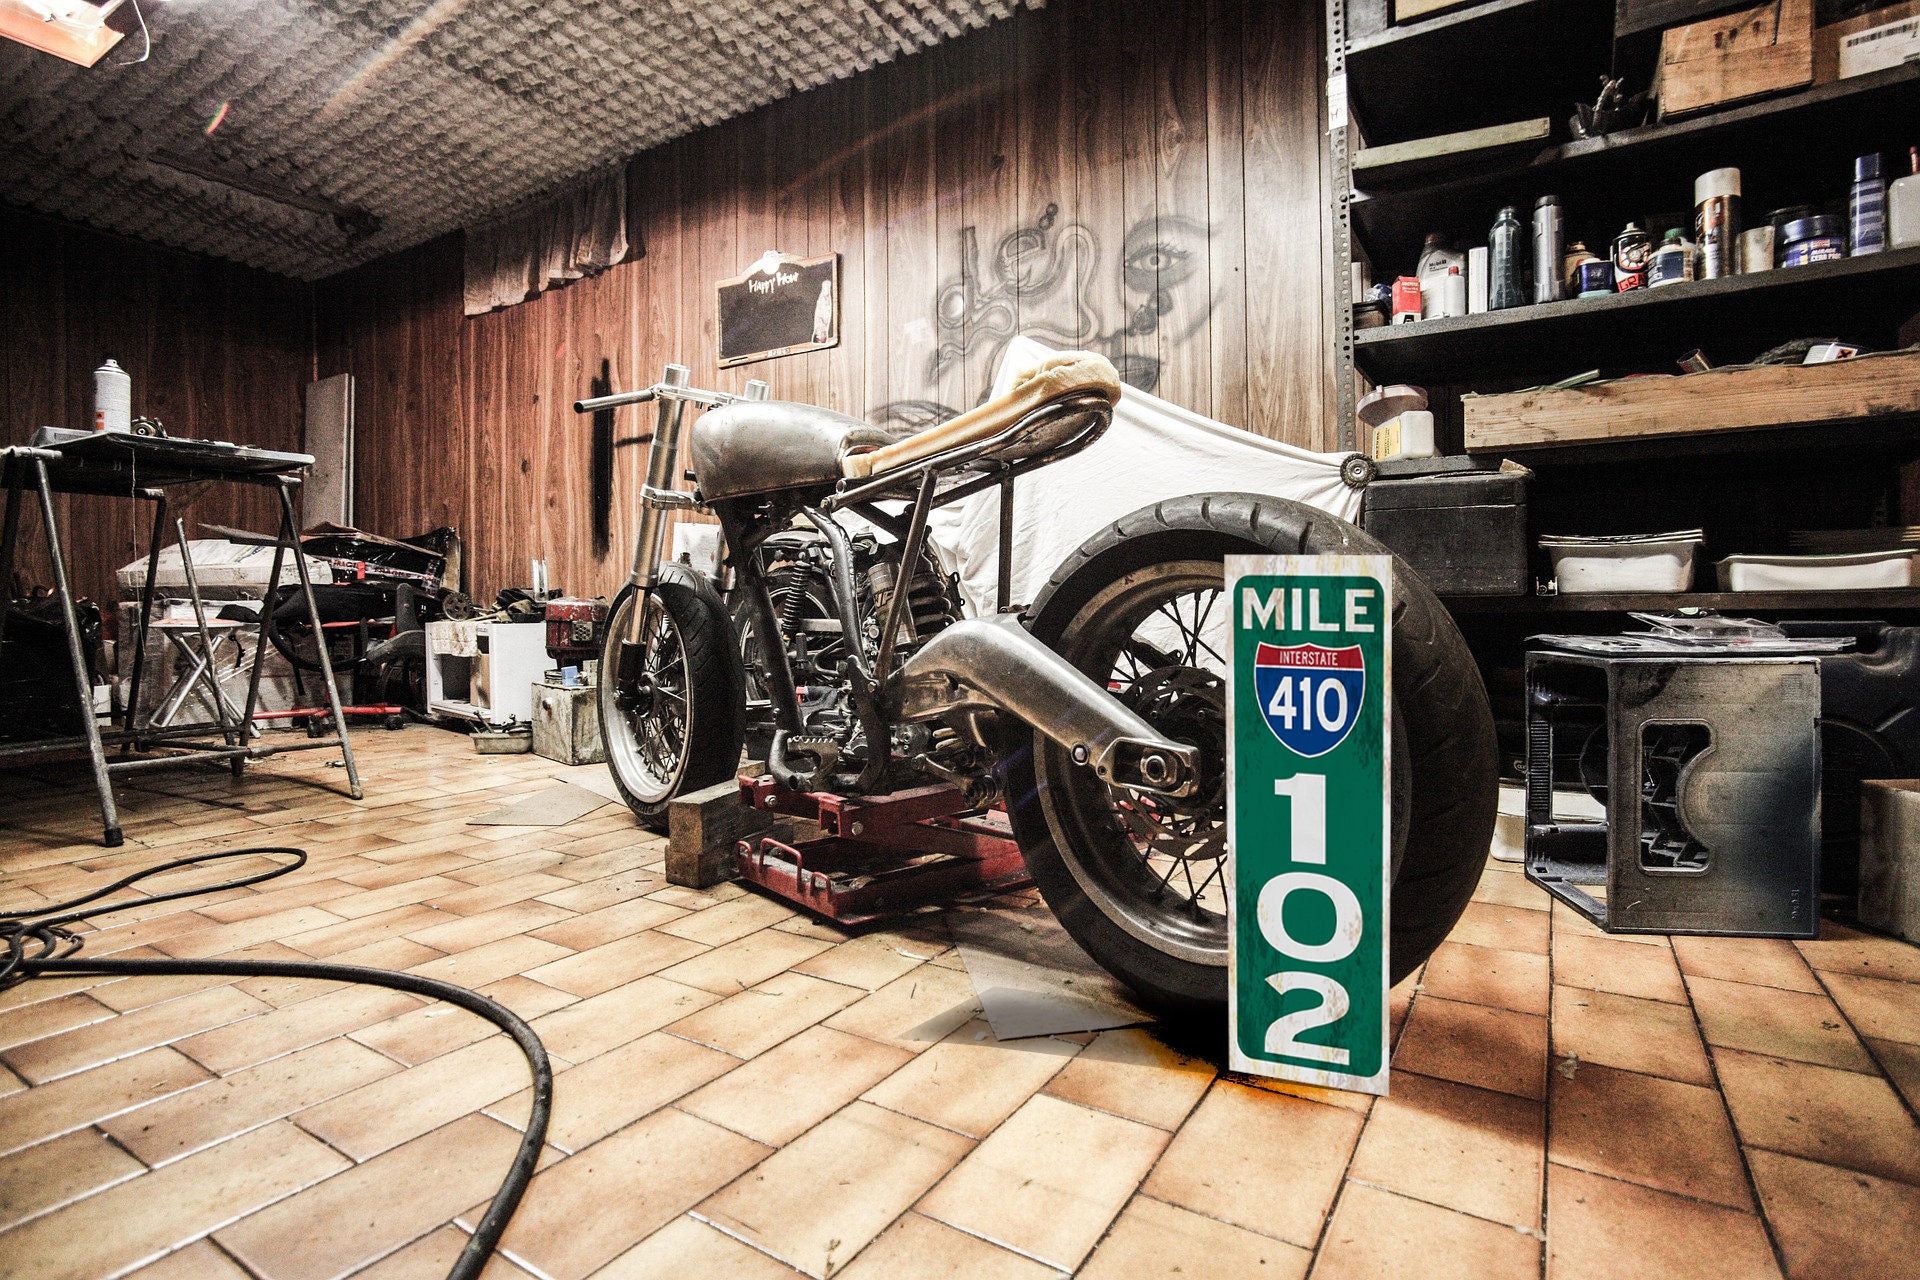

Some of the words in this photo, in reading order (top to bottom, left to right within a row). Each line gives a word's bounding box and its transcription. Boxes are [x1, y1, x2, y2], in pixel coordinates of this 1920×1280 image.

[748, 277, 775, 294] Happy
[1242, 587, 1375, 633] MILE
[1279, 651, 1339, 666] INTERSTATE
[1268, 676, 1348, 732] 410
